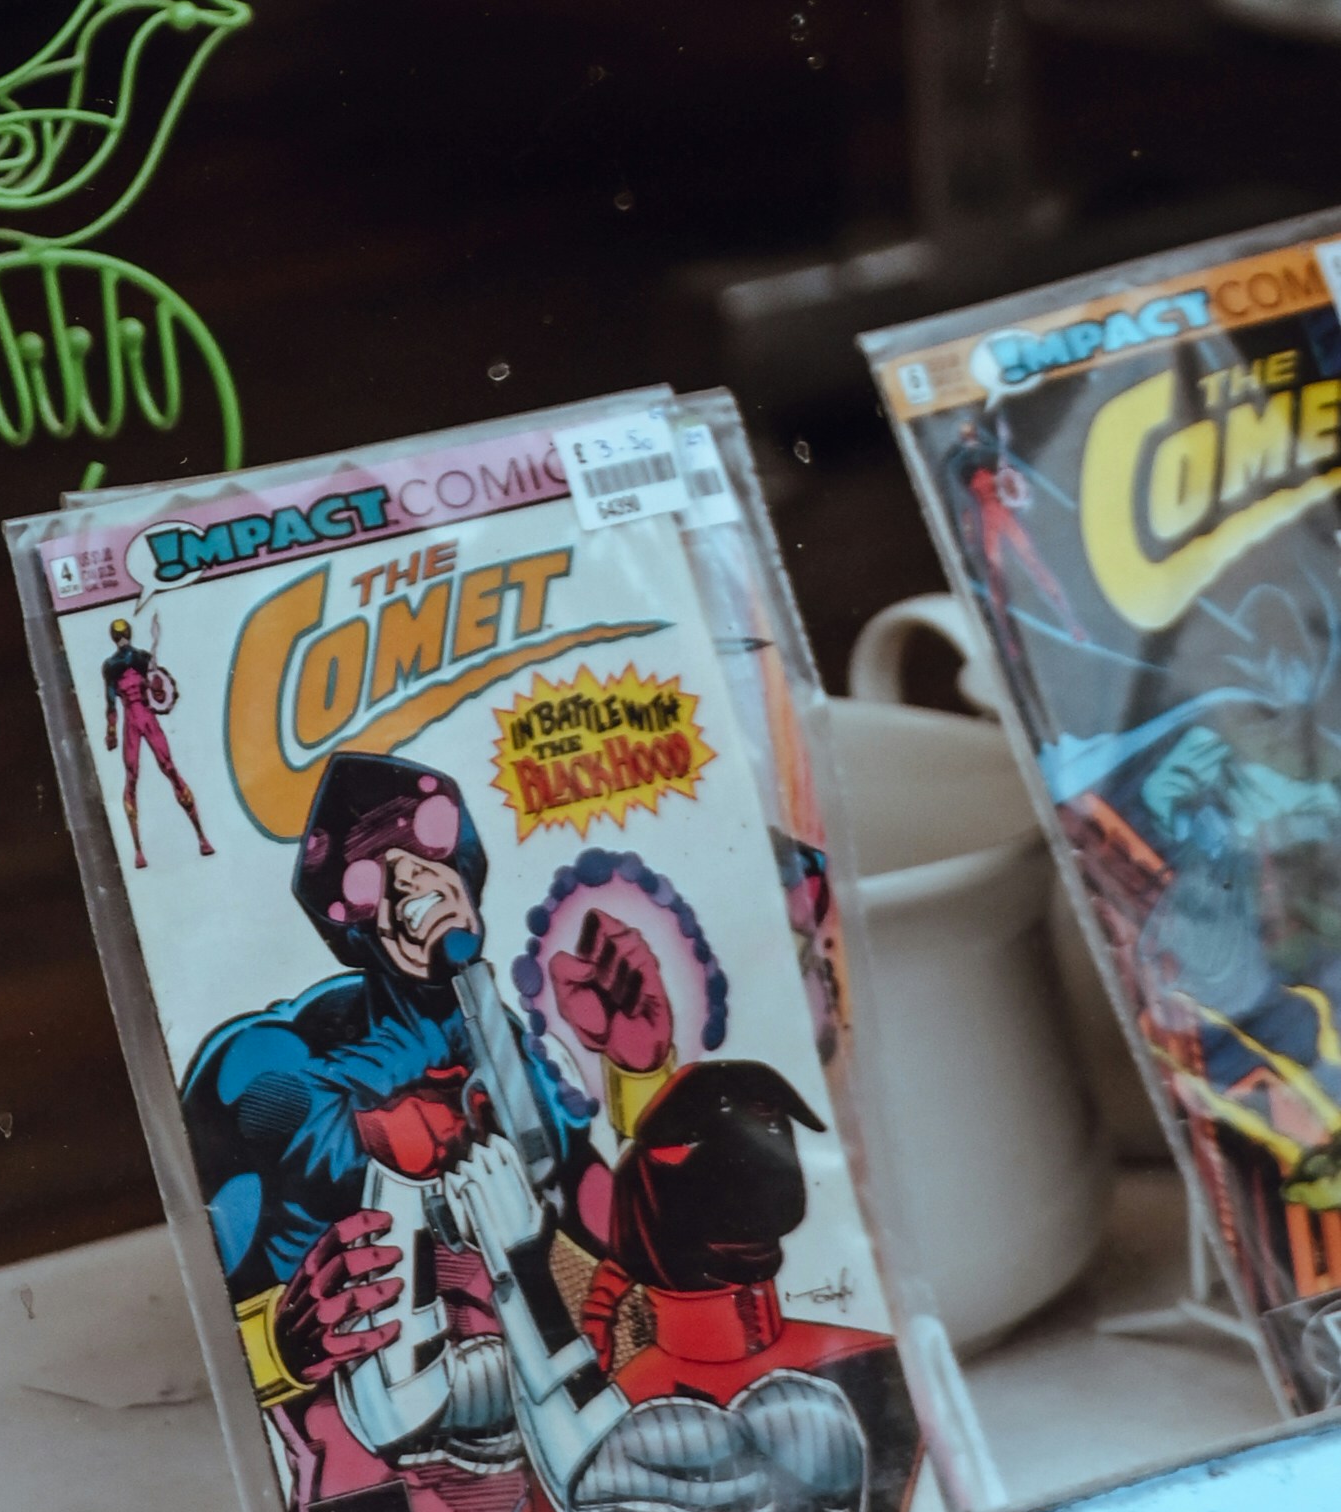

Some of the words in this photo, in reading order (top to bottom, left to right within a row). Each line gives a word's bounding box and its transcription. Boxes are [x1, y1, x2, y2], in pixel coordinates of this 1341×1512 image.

[1198, 349, 1300, 408] THE
[572, 442, 588, 464] £
[60, 561, 73, 582] 4
[351, 538, 459, 608] THE
[223, 545, 575, 844] COMET
[510, 711, 535, 751] IN
[534, 691, 624, 736] BATTLE
[620, 691, 682, 733] WITH
[511, 751, 613, 816] BLACK
[603, 730, 692, 793] HOOD
[532, 734, 583, 761] THE
